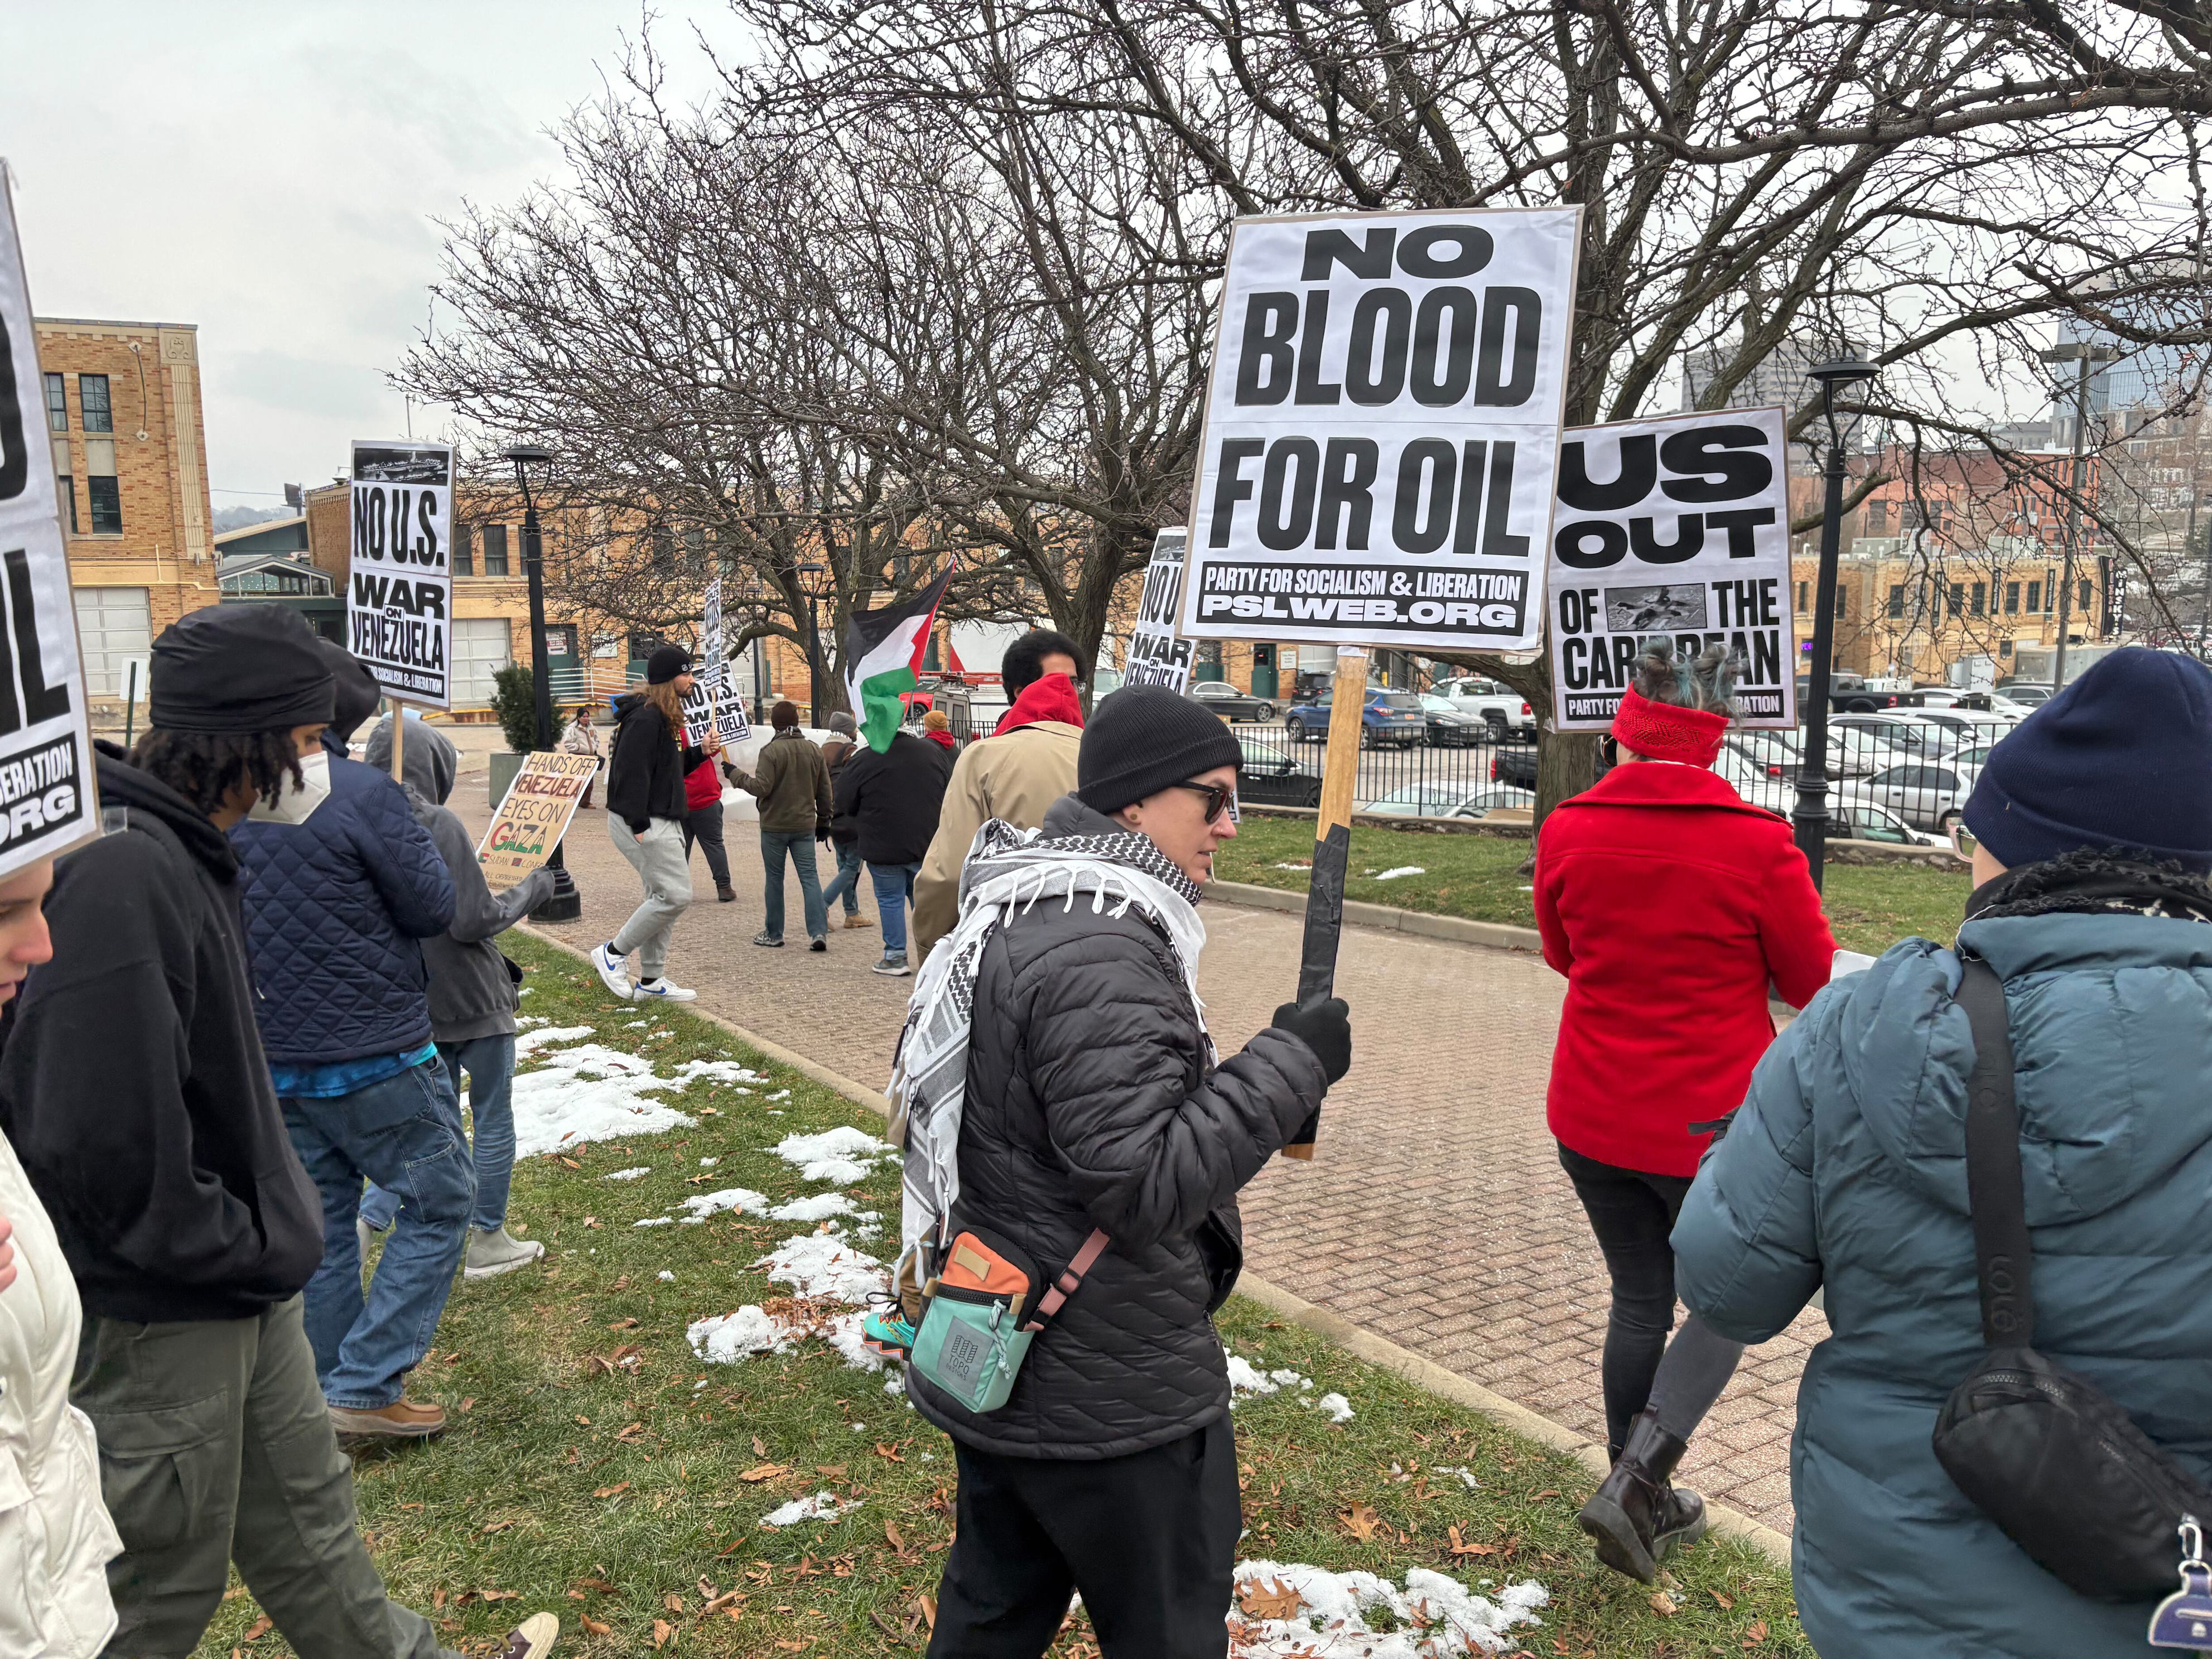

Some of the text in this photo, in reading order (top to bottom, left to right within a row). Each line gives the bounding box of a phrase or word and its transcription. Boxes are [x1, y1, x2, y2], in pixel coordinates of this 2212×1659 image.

[1300, 225, 1494, 281] NO
[1235, 286, 1542, 408] BLOOD
[1557, 425, 1772, 511] US
[1209, 436, 1531, 557] FOR OIL
[354, 487, 445, 567] NO U.S.
[1555, 507, 1775, 568] OUT
[354, 572, 445, 620] WAR
[1140, 565, 1170, 624] NO
[1204, 567, 1521, 601] PARTY FOR SOCIALISM & LIBERATION
[386, 607, 402, 619] ON
[1202, 595, 1516, 628] PSLWEB.ORG
[1559, 578, 1780, 634] OF THE
[352, 610, 444, 671] VENEZUELA
[1132, 633, 1192, 668] WAR
[1124, 661, 1183, 696] VENEZUELA
[1149, 658, 1160, 668] ON
[378, 667, 403, 686] SOCIALISM
[403, 673, 411, 687] &
[411, 673, 442, 694] LIBERATION
[1568, 699, 1605, 716] PARTY
[1606, 698, 1622, 715] FO
[689, 714, 746, 741] VENZUELA
[525, 754, 596, 775] HANDS OFF
[513, 773, 584, 798] VENEZUELA
[500, 798, 566, 823] EYES ON
[490, 821, 548, 855] GAZA
[489, 855, 510, 865] SUDAN
[950, 1354, 969, 1375] TOPO
